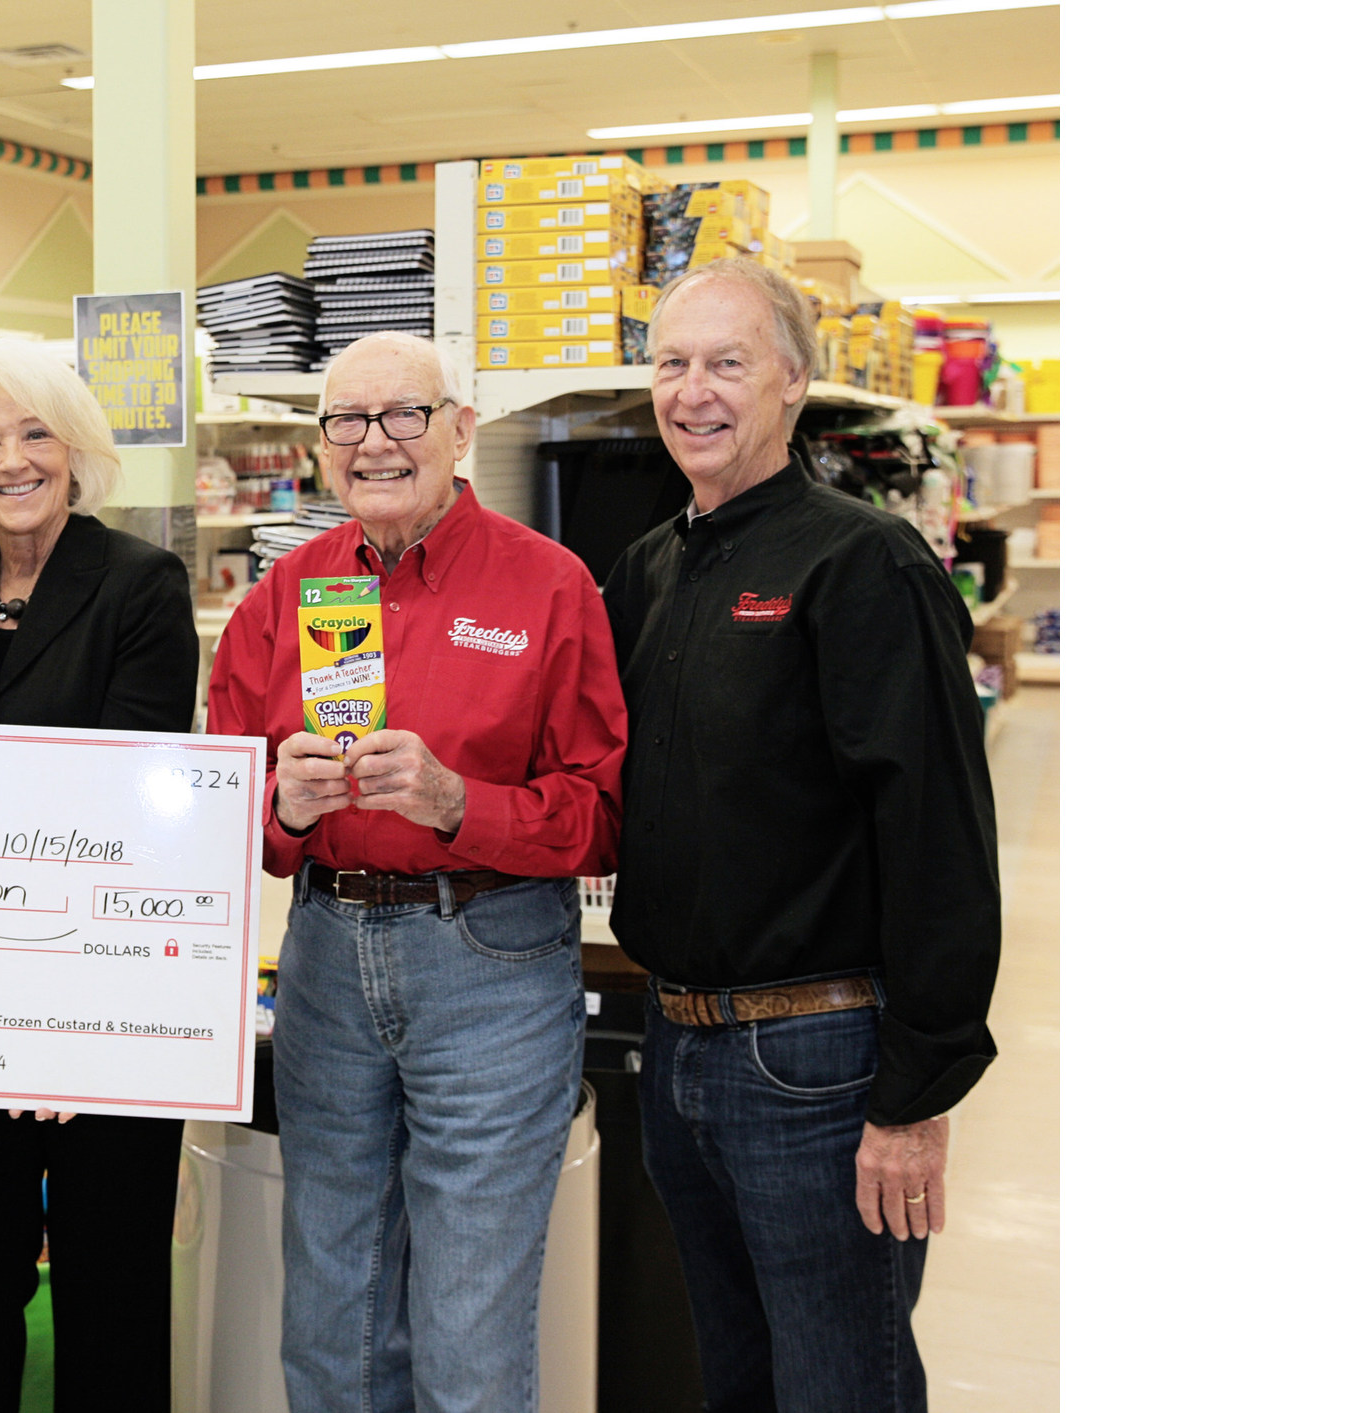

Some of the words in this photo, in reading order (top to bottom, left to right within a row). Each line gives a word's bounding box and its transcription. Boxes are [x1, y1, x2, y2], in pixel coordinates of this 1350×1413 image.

[99, 311, 162, 336] PLEASE
[83, 337, 128, 360] LIMIT
[131, 334, 179, 358] YOUR
[87, 359, 175, 383] SHOPPING
[130, 383, 152, 405] TO
[154, 382, 177, 405] 30
[305, 588, 322, 603] 12
[311, 616, 366, 630] Crayola
[447, 617, 529, 649] Freddy's
[453, 640, 521, 656] STEAKBURGERS
[309, 674, 333, 685] Thank
[341, 664, 372, 677] Teacher
[351, 673, 371, 684] WIN!
[315, 700, 372, 714] COLORED
[319, 712, 370, 727] PENCILS
[1, 829, 123, 867] 10/15/2018
[84, 942, 151, 959] DOLLARS
[46, 1017, 102, 1032] Custard
[105, 1020, 115, 1032] &
[120, 1021, 214, 1039] Steakburgers
